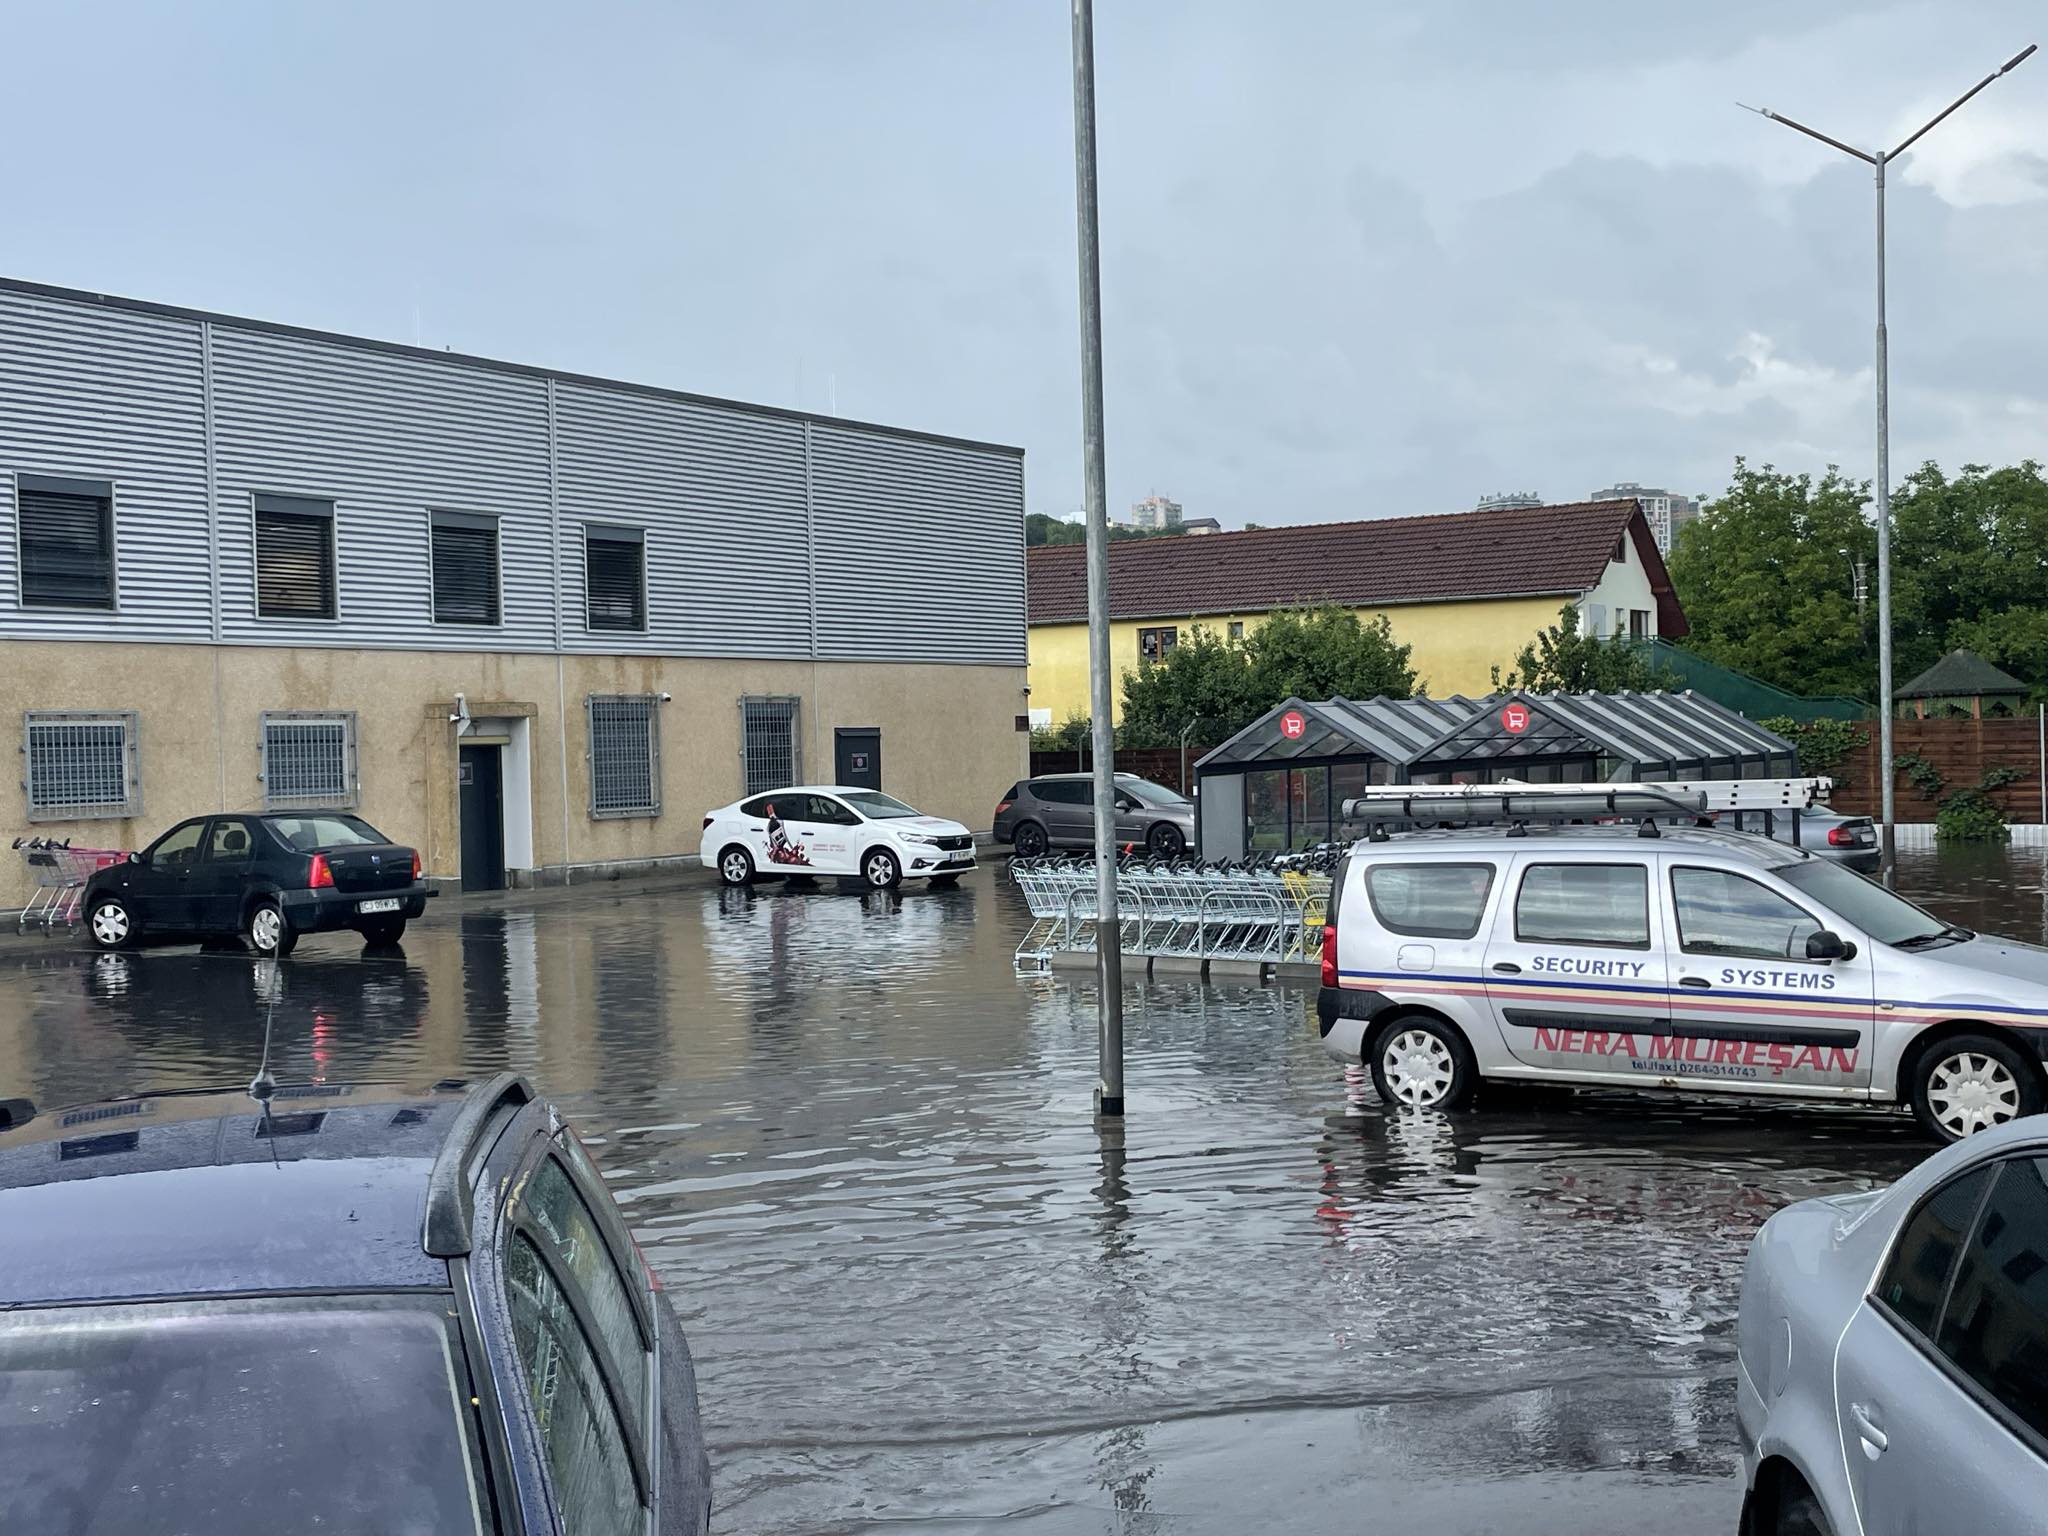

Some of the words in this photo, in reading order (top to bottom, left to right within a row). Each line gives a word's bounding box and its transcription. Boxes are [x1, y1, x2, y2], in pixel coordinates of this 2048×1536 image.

[1532, 956, 1645, 978] SECURITY
[1720, 968, 1835, 990] SYSTEMS
[1533, 1026, 1638, 1058] NERA
[1679, 1063, 1757, 1078] 0264-314743
